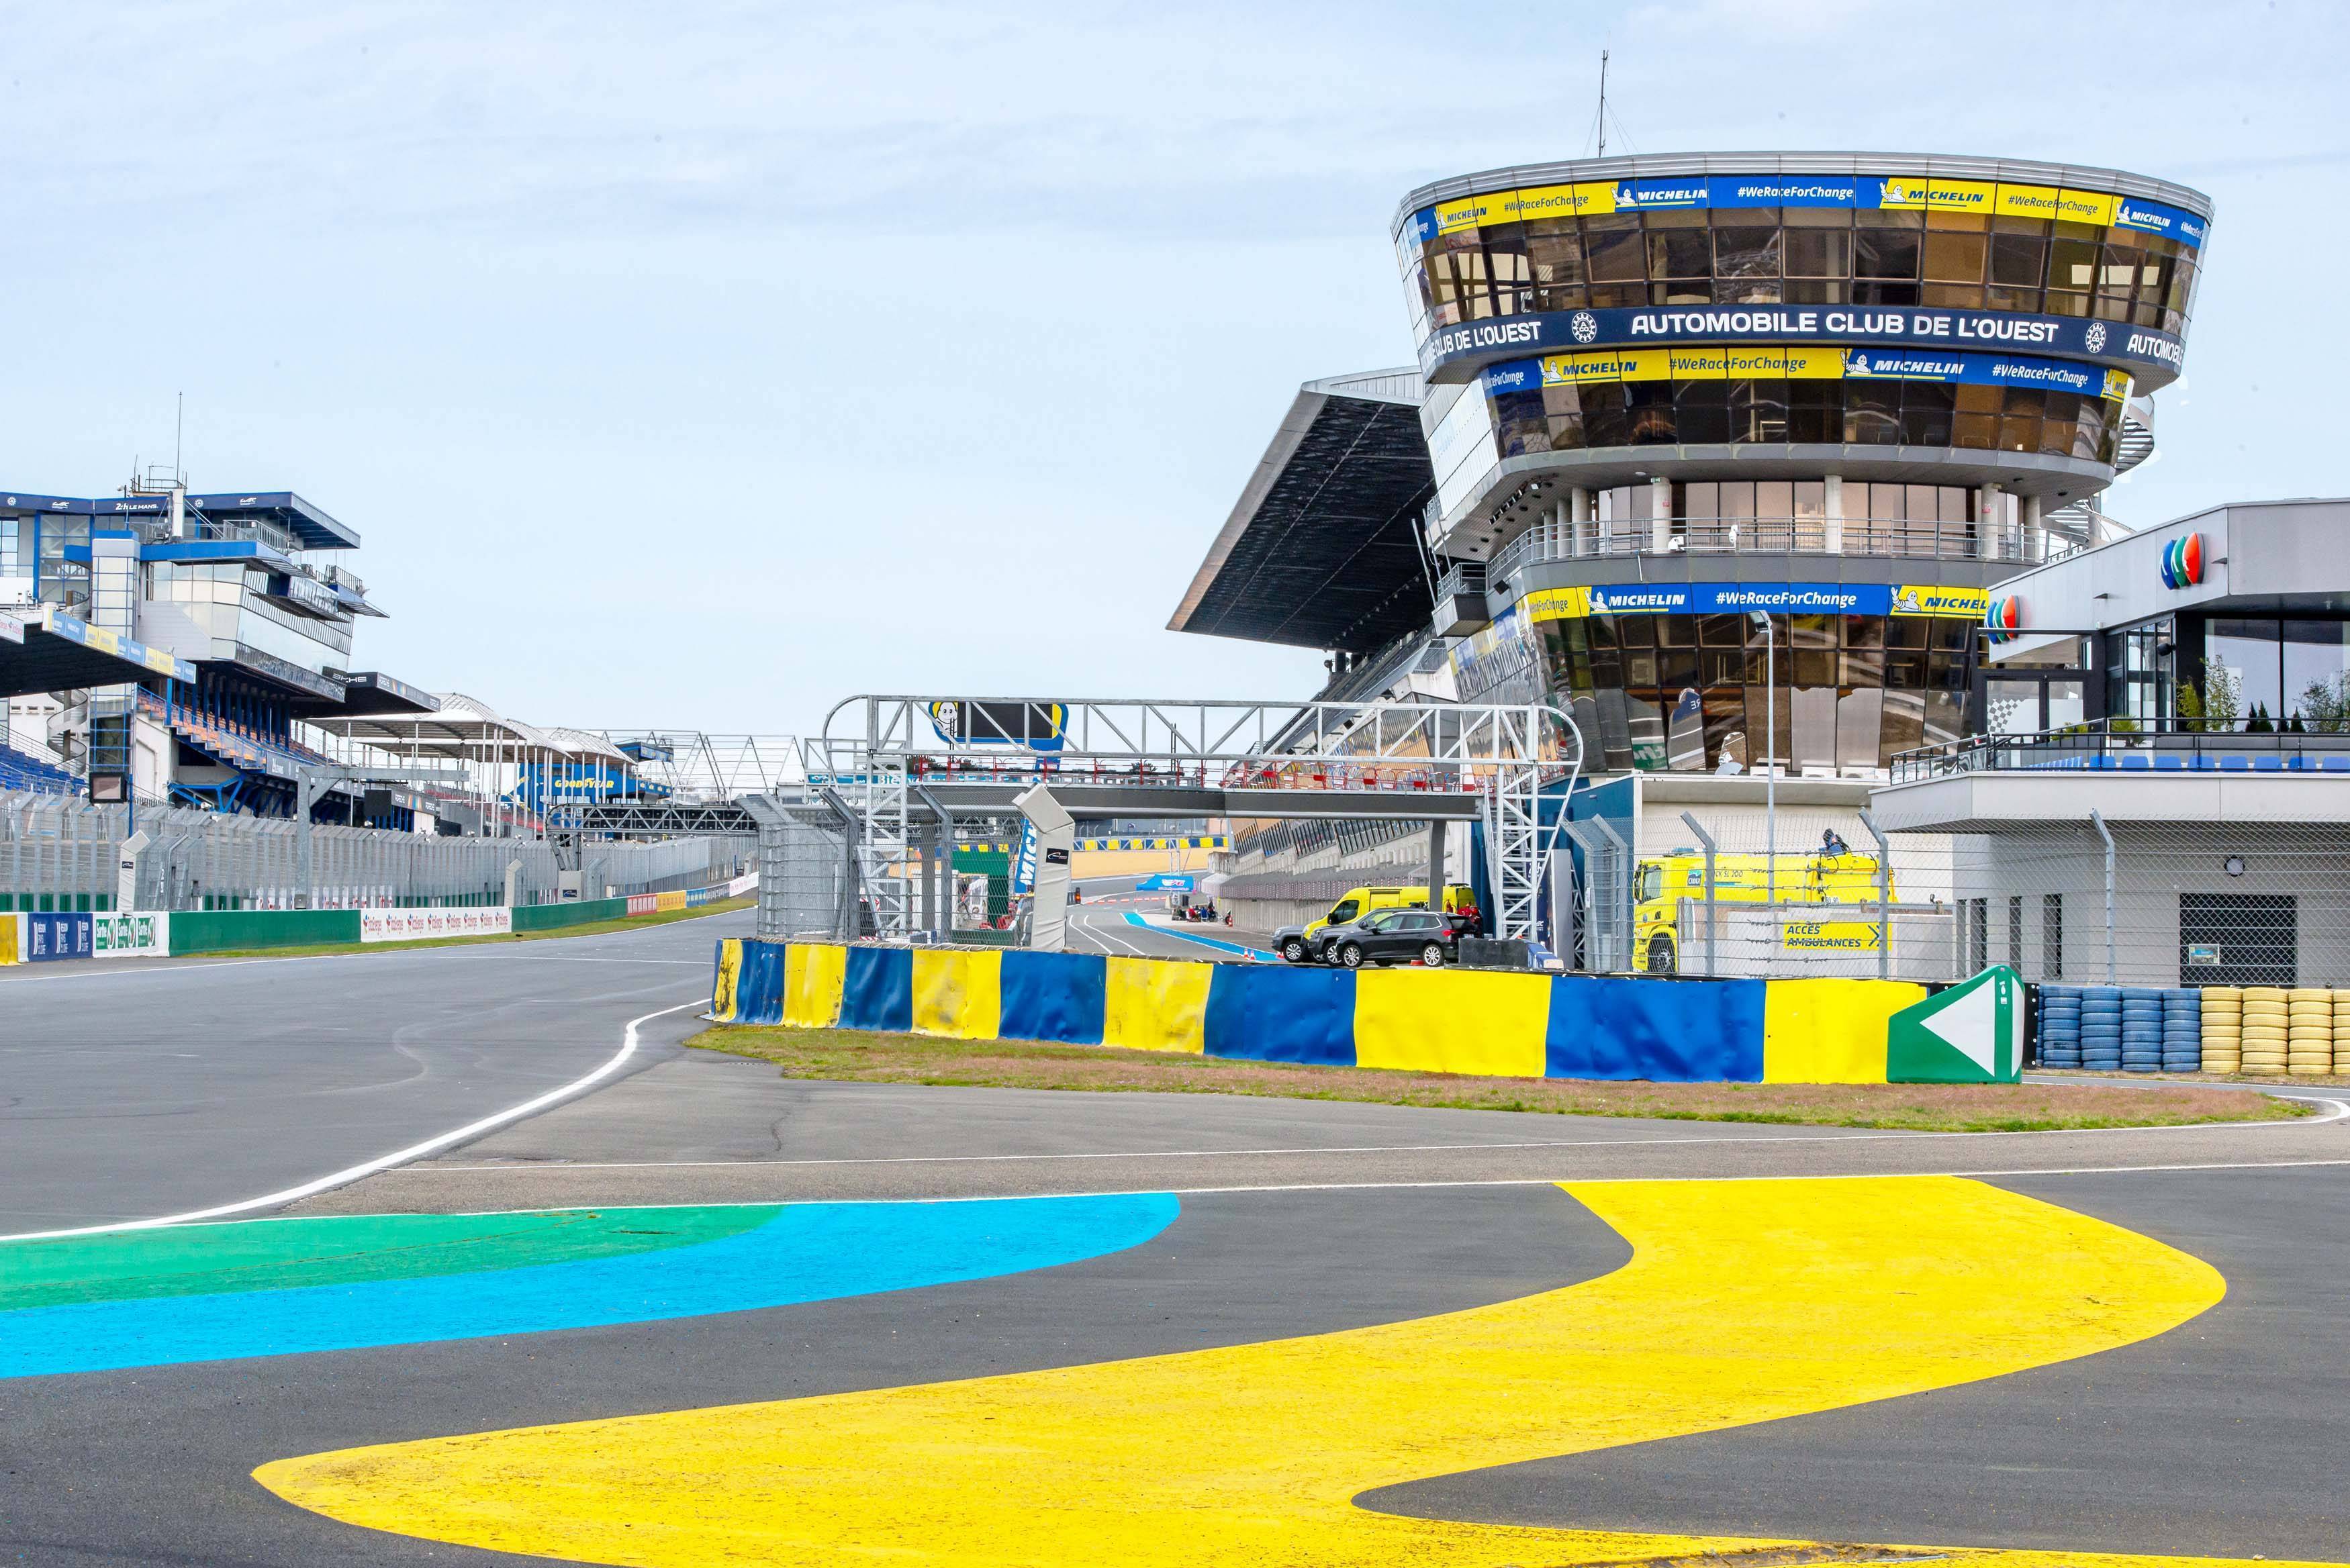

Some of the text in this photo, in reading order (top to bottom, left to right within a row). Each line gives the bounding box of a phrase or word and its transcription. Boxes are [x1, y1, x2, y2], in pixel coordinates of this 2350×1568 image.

[1638, 189, 1708, 201] MICHELIN
[1738, 186, 1854, 200] #WeRaceForChange
[1908, 190, 1984, 203] MICHELIN
[1504, 194, 1589, 213] #WeRaceForChange
[2008, 195, 2098, 215] #WeRaceForChange
[1447, 207, 1487, 223] MICHELIN
[2131, 211, 2171, 228] MICHELIN
[1632, 312, 2059, 343] AUTOMOBILE CLUB DE L'OUEST
[1455, 330, 1472, 350] DE
[1473, 322, 1542, 347] L'OUEST
[1563, 361, 1637, 376] MICHELIN
[1670, 357, 1806, 372] #WeRaceForChange
[1874, 360, 1965, 375] MICHELIN
[1993, 364, 2087, 388] #WeRaceForChange
[1609, 594, 1685, 606] MICHELIN
[1716, 592, 1856, 608] #WeRaceForChange
[1924, 597, 1986, 609] MICHEL
[1787, 938, 1861, 947] AMBULANCES
